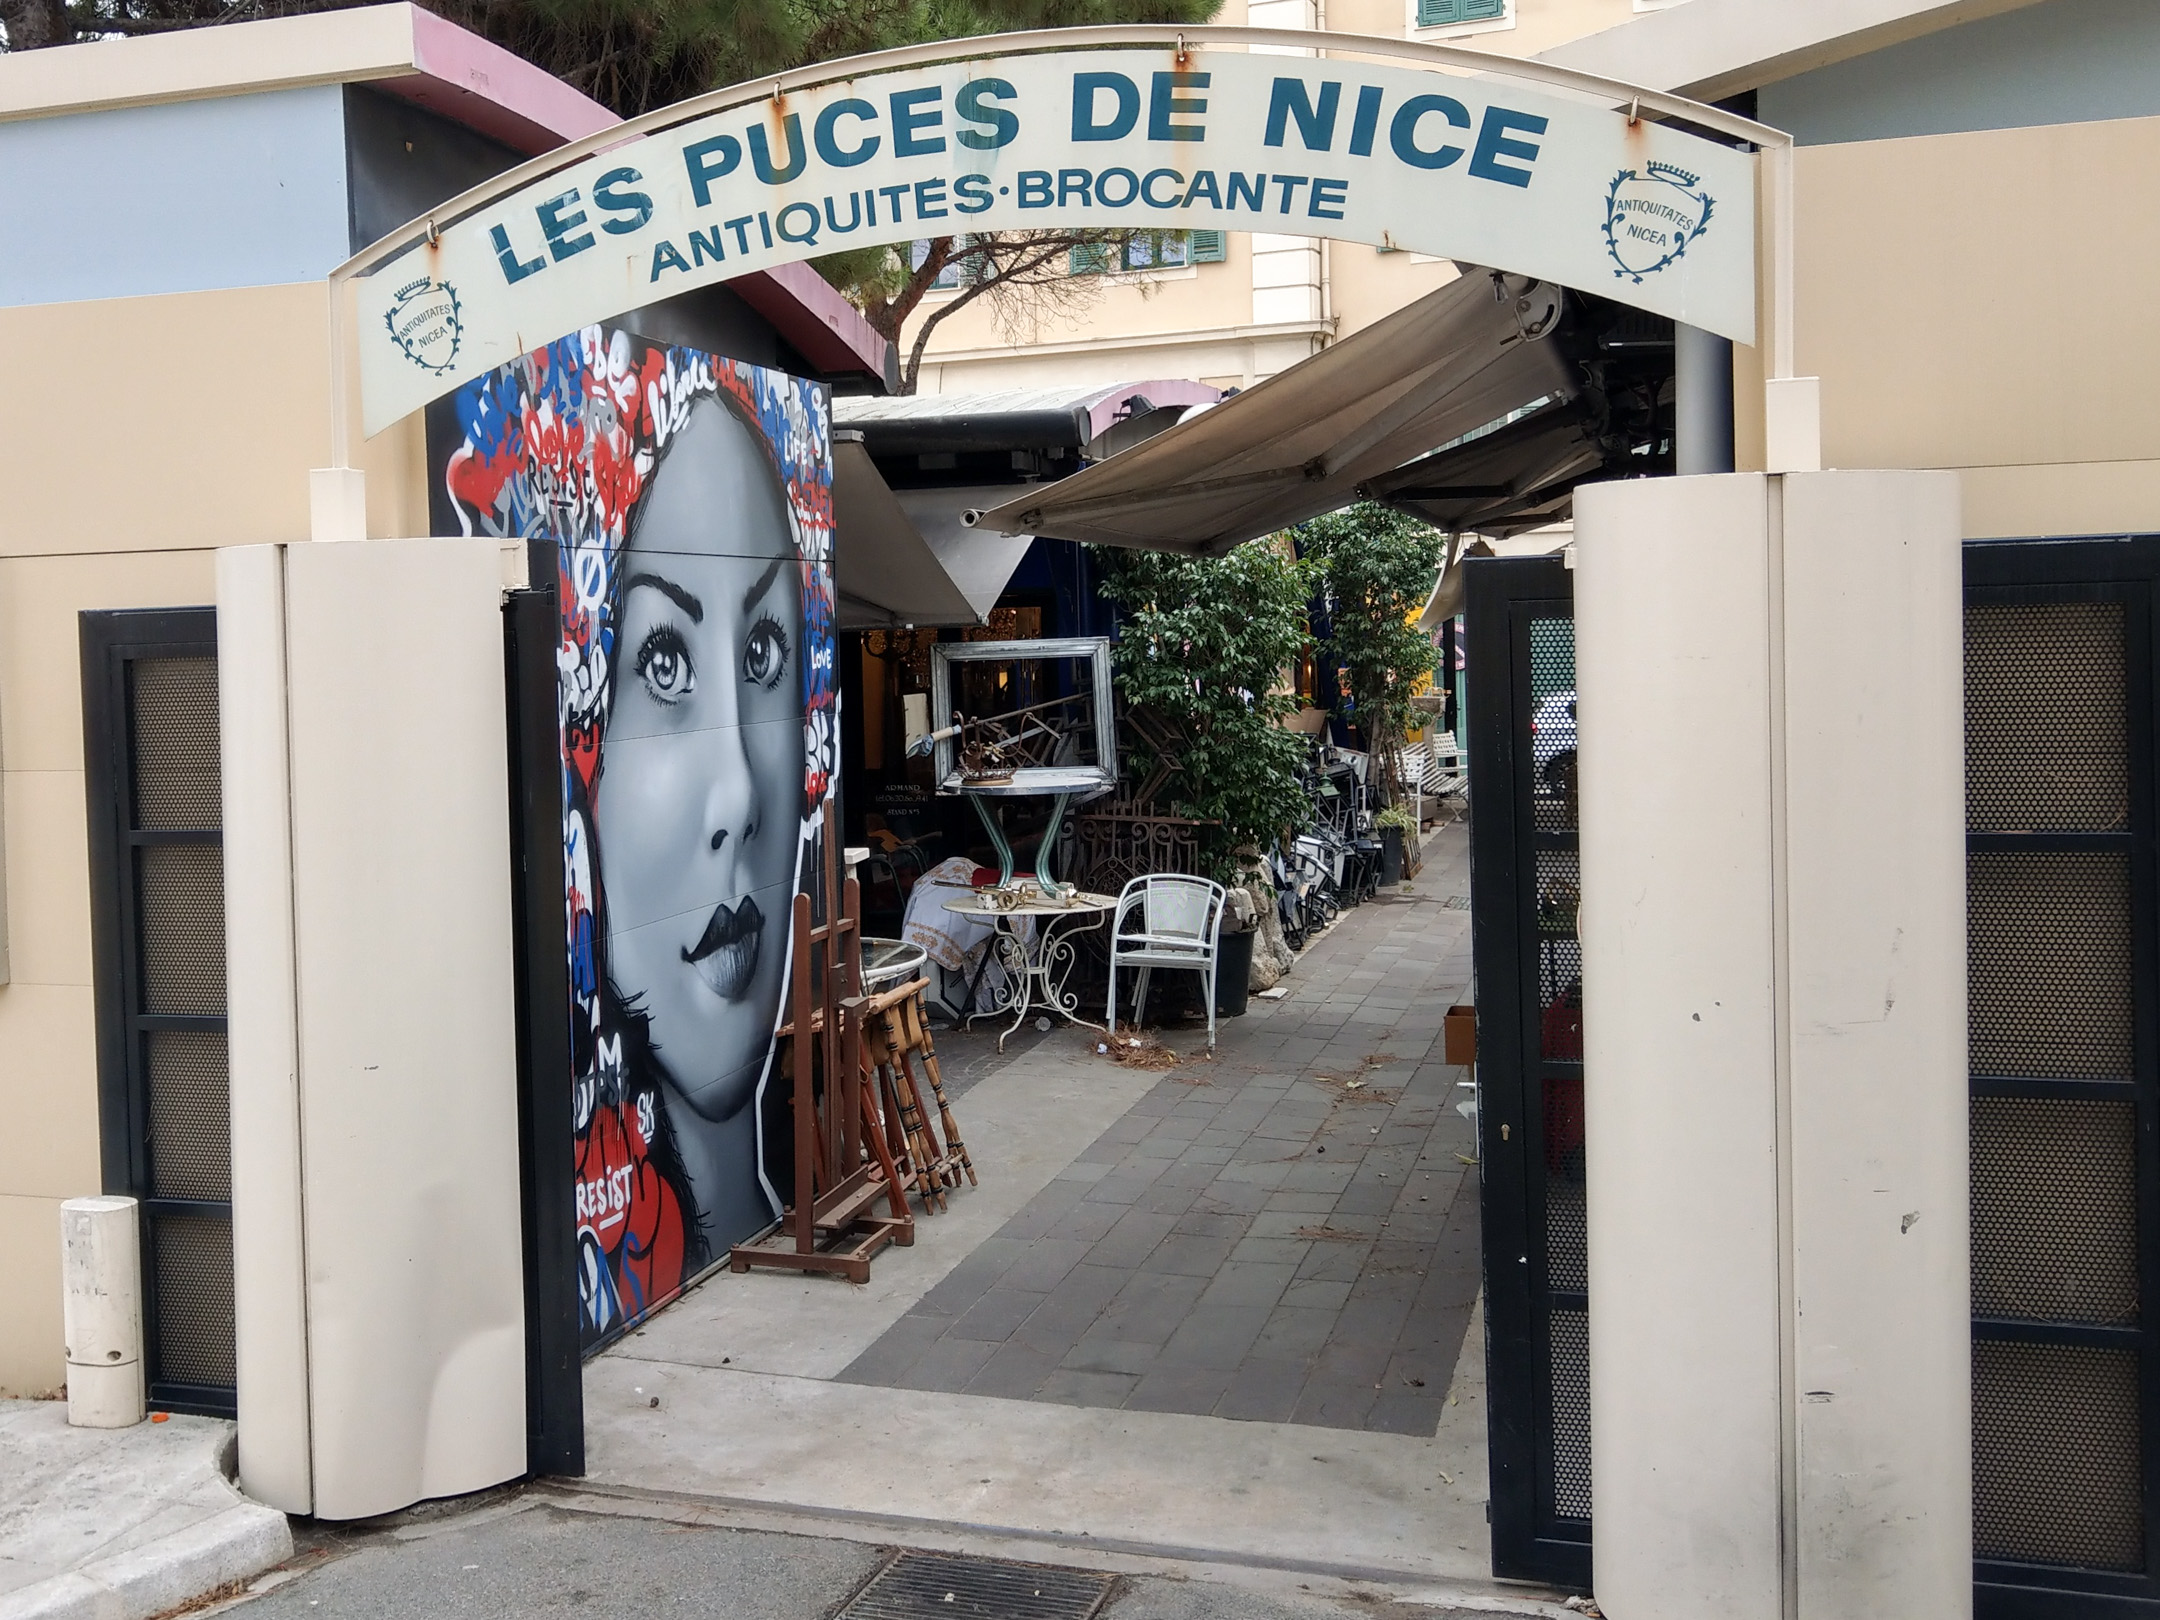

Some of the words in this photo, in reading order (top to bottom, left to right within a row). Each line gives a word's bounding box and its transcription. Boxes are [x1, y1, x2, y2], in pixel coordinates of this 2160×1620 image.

[488, 166, 655, 285] LES
[683, 77, 1019, 208] PUCES
[1071, 71, 1212, 142] DE
[1264, 76, 1549, 189] NICE
[1616, 199, 1694, 231] ANTIQUITATES
[1627, 224, 1667, 247] NICEA
[400, 303, 451, 341] ANTIQUITATES
[418, 326, 448, 348] NICEA
